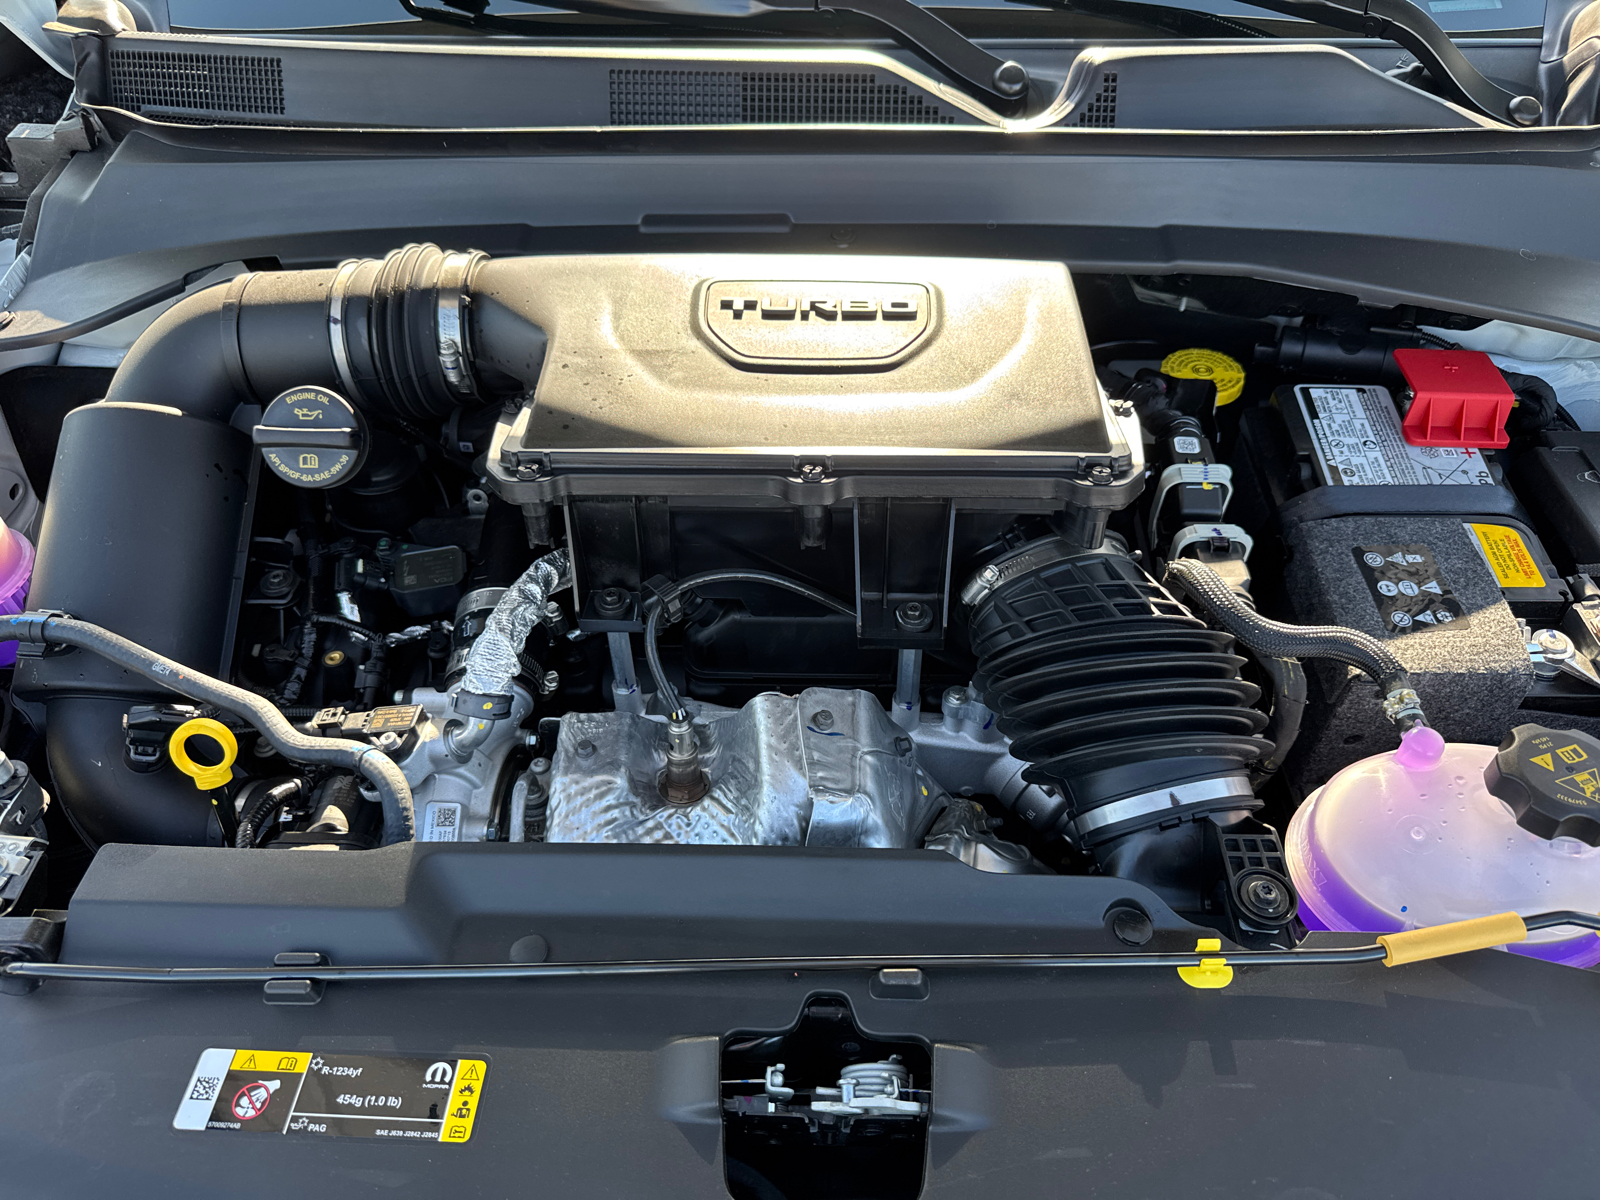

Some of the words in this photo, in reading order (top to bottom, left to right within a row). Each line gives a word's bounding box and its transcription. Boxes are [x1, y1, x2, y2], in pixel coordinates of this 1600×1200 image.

[720, 296, 918, 322] TURBO
[286, 392, 316, 404] ENGINE
[317, 394, 330, 405] OIL
[269, 453, 281, 466] API
[1482, 531, 1495, 549] BATTERY
[1504, 534, 1517, 551] VOLTAGE
[1491, 551, 1501, 560] AGM
[1499, 538, 1520, 573] NON-SPILLABLE
[1499, 554, 1508, 562] NOT
[1513, 552, 1526, 567] CHARGE
[1497, 562, 1509, 579] SEALED
[321, 1066, 362, 1077] R-1234yf
[336, 1094, 363, 1107] 454g
[365, 1095, 384, 1108] (1.0
[386, 1096, 402, 1109] lb)
[308, 1123, 327, 1132] PAG
